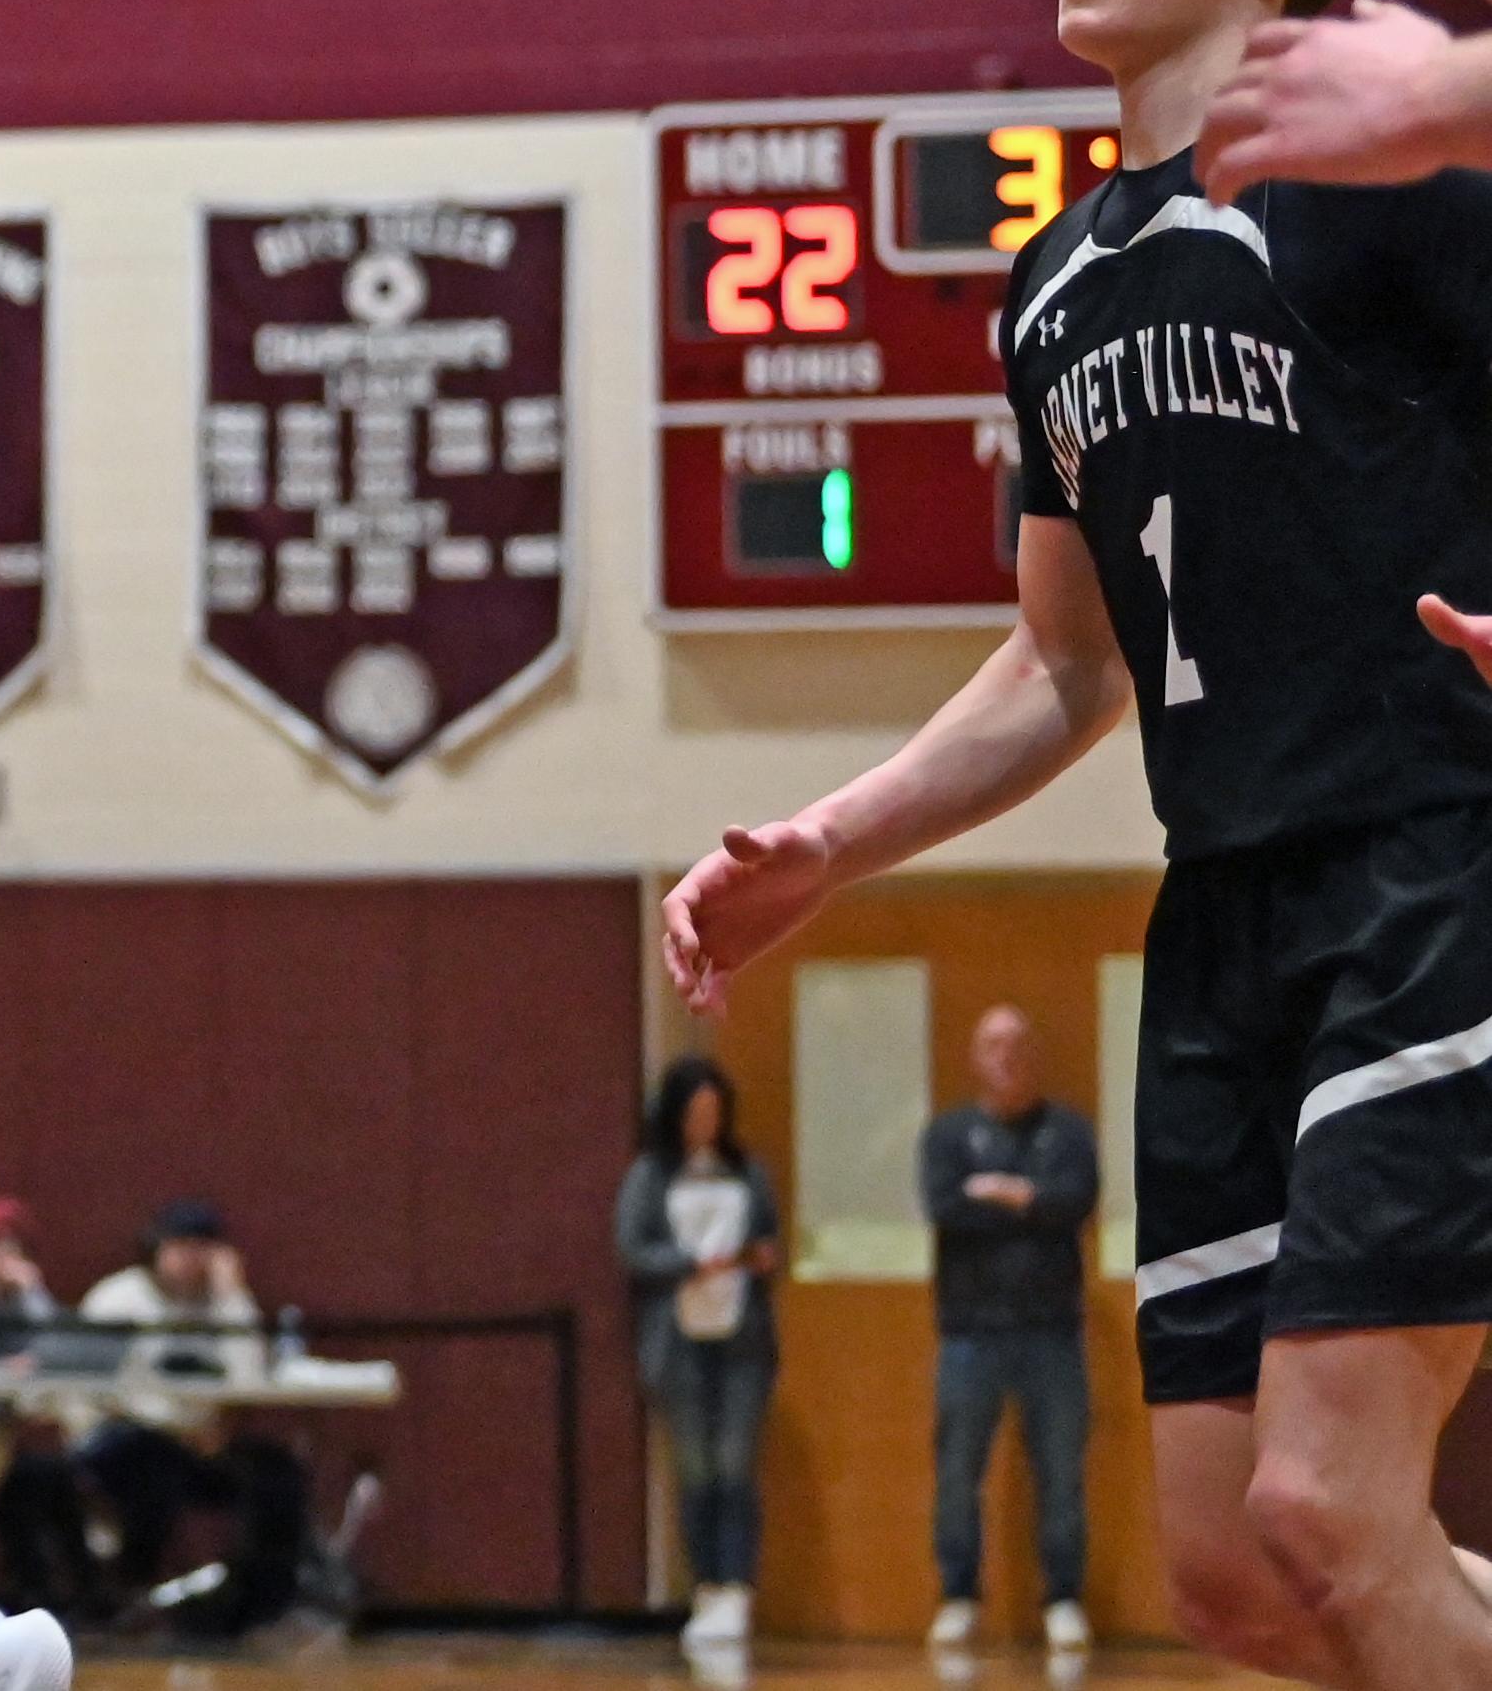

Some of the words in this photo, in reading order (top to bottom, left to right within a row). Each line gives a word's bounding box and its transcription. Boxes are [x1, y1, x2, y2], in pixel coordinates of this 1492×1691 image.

[685, 127, 849, 194] HOME
[705, 204, 859, 335] 22
[744, 343, 883, 395] BONUS
[723, 423, 851, 471] FOULS
[820, 467, 855, 571] 1
[1138, 493, 1207, 708] 1
